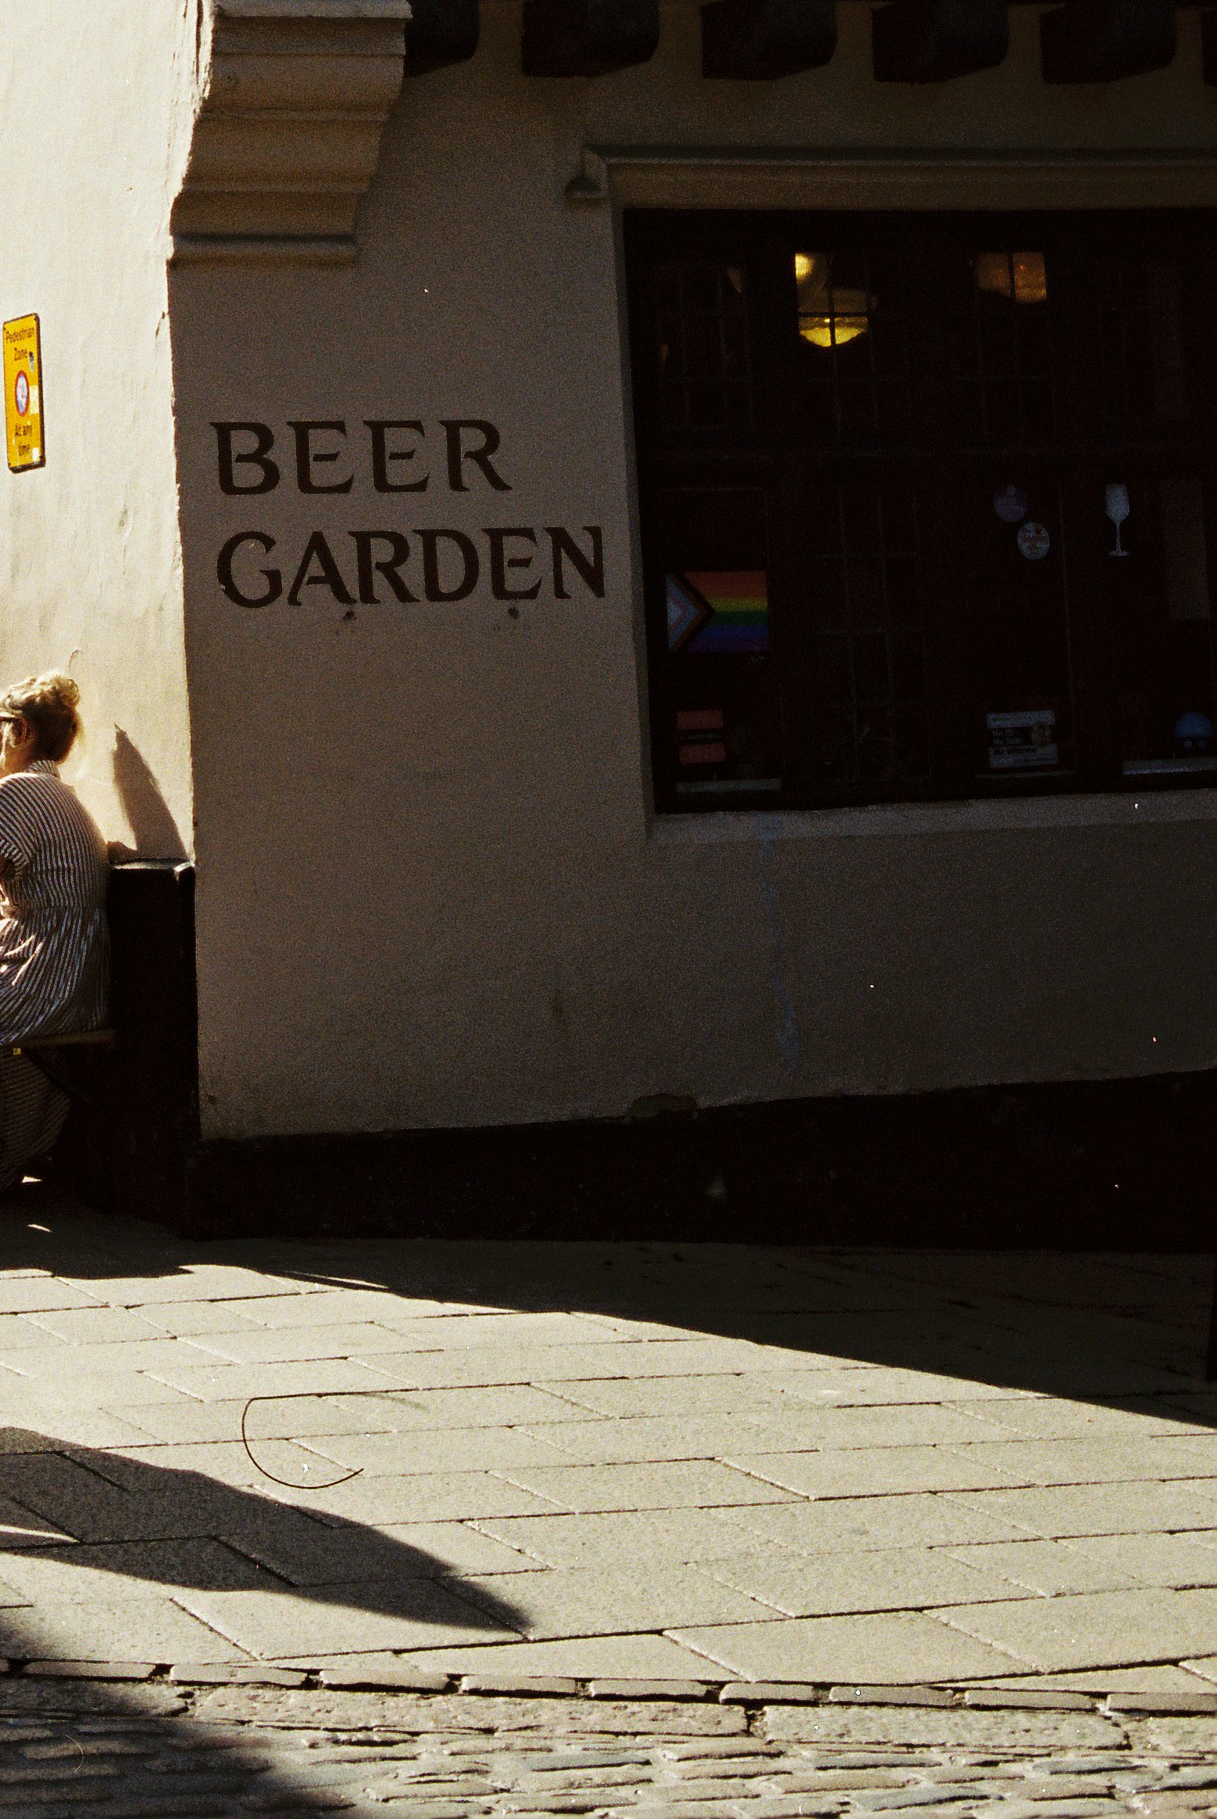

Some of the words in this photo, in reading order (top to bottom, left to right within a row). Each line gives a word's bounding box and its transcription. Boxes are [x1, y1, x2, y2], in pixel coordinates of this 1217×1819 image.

[5, 326, 35, 344] Pedestrian
[14, 346, 28, 362] Zone
[208, 419, 513, 496] BEER
[216, 525, 606, 609] GARDEN
